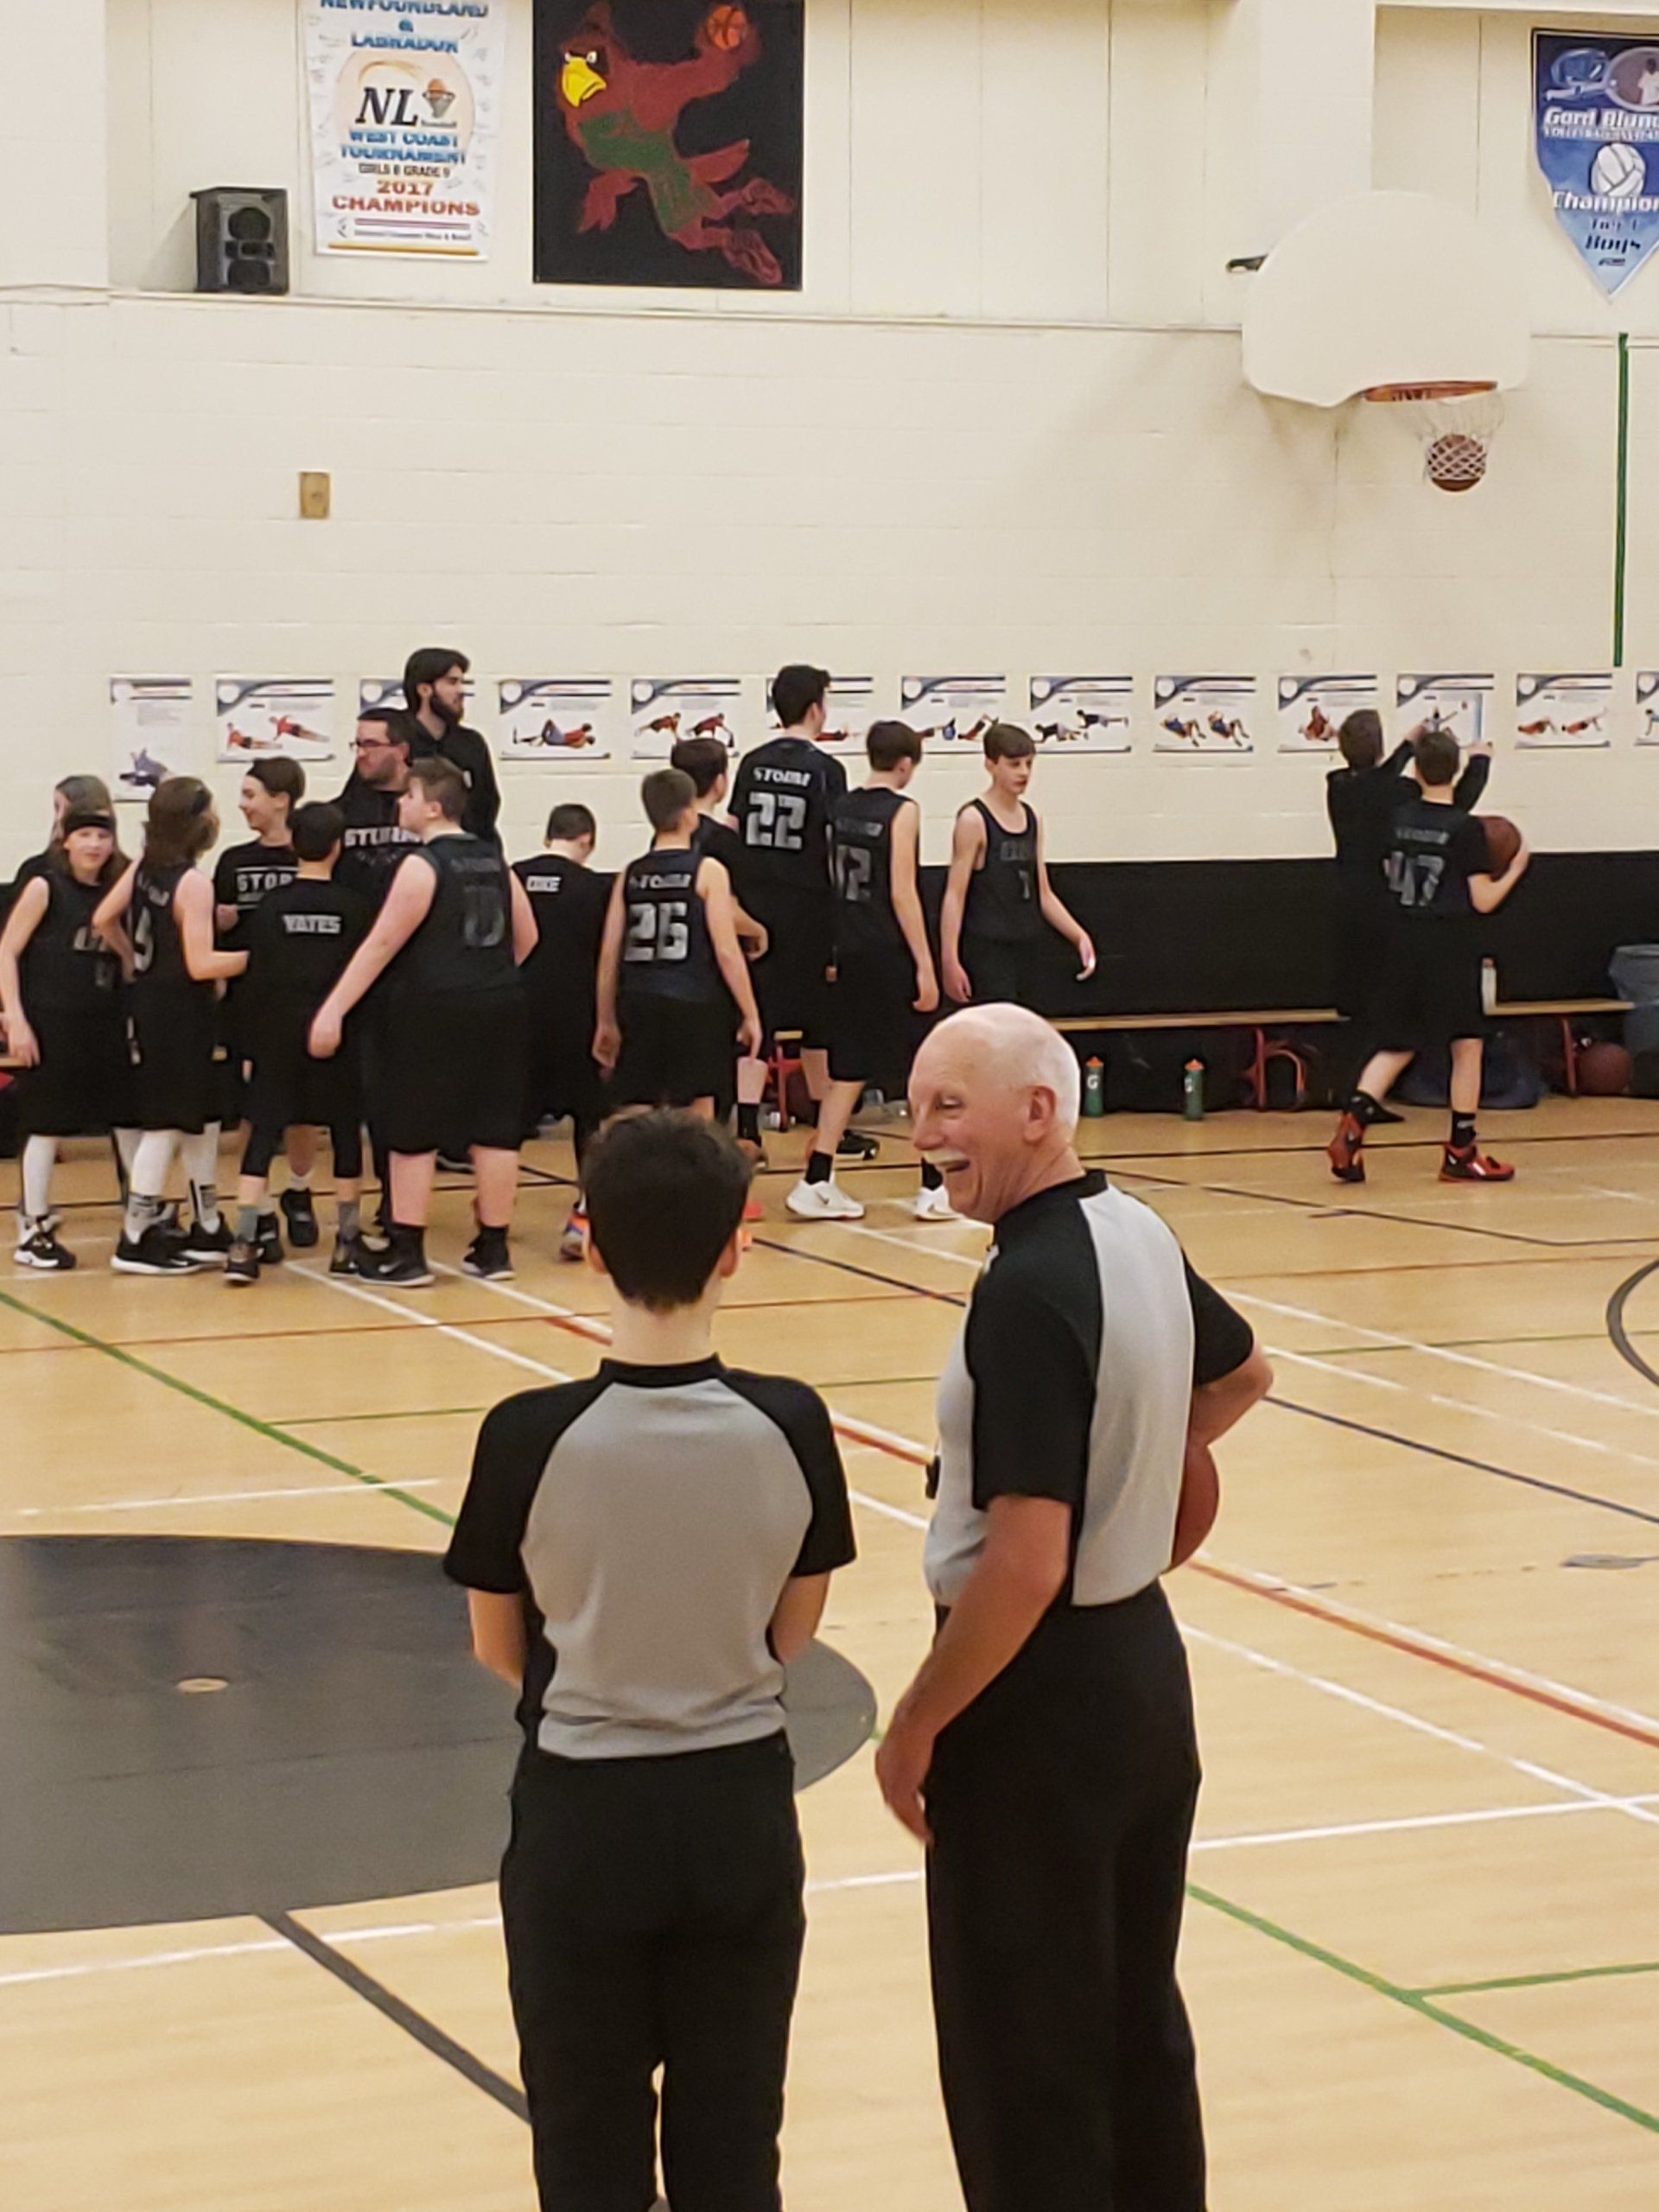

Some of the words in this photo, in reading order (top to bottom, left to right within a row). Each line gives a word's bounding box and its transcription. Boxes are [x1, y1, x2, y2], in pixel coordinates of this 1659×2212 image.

[351, 33, 459, 53] LABRADOR
[355, 86, 419, 127] NL
[1543, 106, 1597, 125] Gord
[349, 130, 396, 143] WEST
[402, 133, 458, 148] COAST
[341, 145, 465, 164] TOURNAMENT
[377, 180, 435, 196] 2017
[333, 196, 480, 216] CHAMPIONS
[753, 766, 813, 787] STORM
[745, 791, 806, 849] 22
[282, 913, 342, 934] YATES
[624, 901, 689, 962] 26
